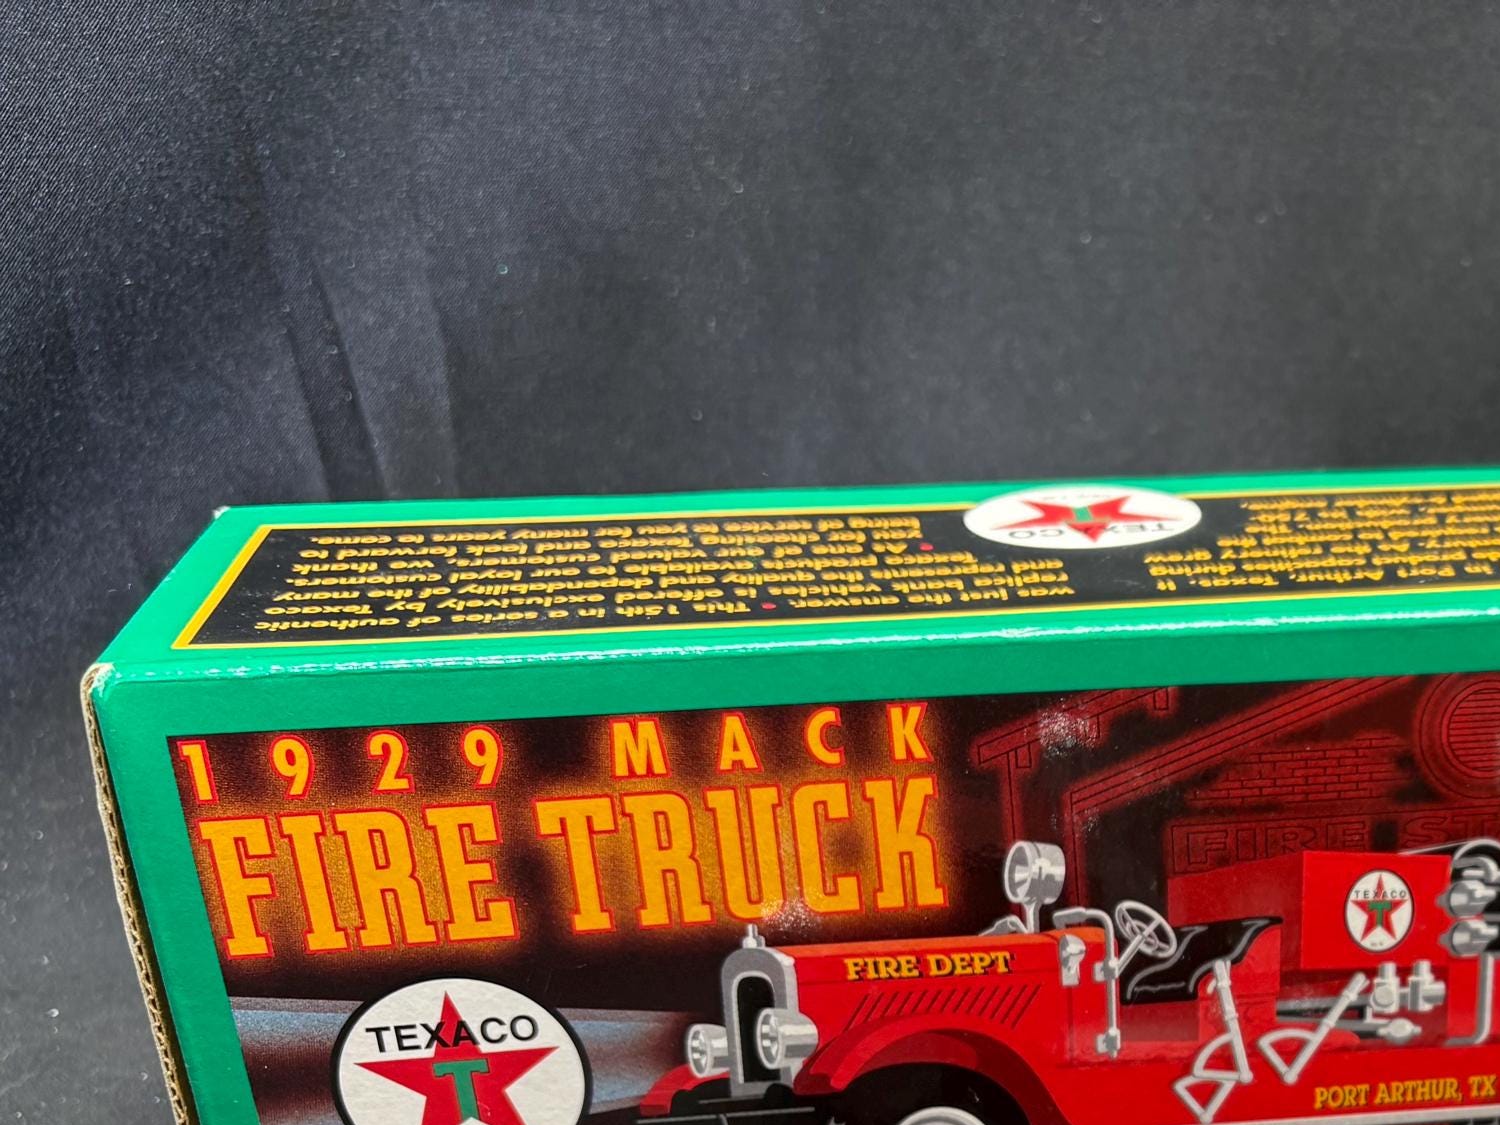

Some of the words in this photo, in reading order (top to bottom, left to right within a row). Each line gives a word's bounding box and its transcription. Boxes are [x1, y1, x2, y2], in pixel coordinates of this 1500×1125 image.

[761, 554, 878, 571] products
[884, 551, 978, 565] Texaco
[530, 566, 580, 577] our
[623, 560, 754, 575] available
[869, 560, 1005, 579] represents
[1010, 559, 1063, 574] and
[287, 572, 442, 586] customers.
[448, 568, 522, 583] loyal
[658, 574, 715, 588] and
[721, 569, 815, 585] quality
[820, 570, 864, 582] the
[973, 571, 1068, 589] replica
[457, 576, 653, 595] dependability
[768, 582, 881, 597] vehicles
[891, 578, 964, 593] bank
[1016, 585, 1074, 597] was
[273, 590, 360, 601] many
[366, 588, 413, 599] the
[614, 588, 723, 604] offered
[907, 592, 952, 605] the
[957, 587, 1008, 601] just
[436, 593, 605, 611] exclusively
[693, 601, 751, 613] This
[789, 595, 900, 608] answer.
[264, 604, 373, 615] Texaco
[450, 610, 538, 623] series
[615, 603, 679, 617] 15th
[255, 617, 400, 631] authentic
[176, 726, 503, 803] 1929
[610, 702, 931, 778] MACK
[199, 801, 519, 959] FIRE
[535, 775, 949, 935] TRUCK
[1353, 889, 1407, 899] TEXACO
[844, 954, 920, 981] FIRE
[926, 951, 1013, 976] DEPT
[365, 1014, 540, 1053] TEXACO
[1314, 1083, 1369, 1110] PORT
[1374, 1077, 1463, 1105] ARTHUR,
[1468, 1074, 1497, 1097] TX
